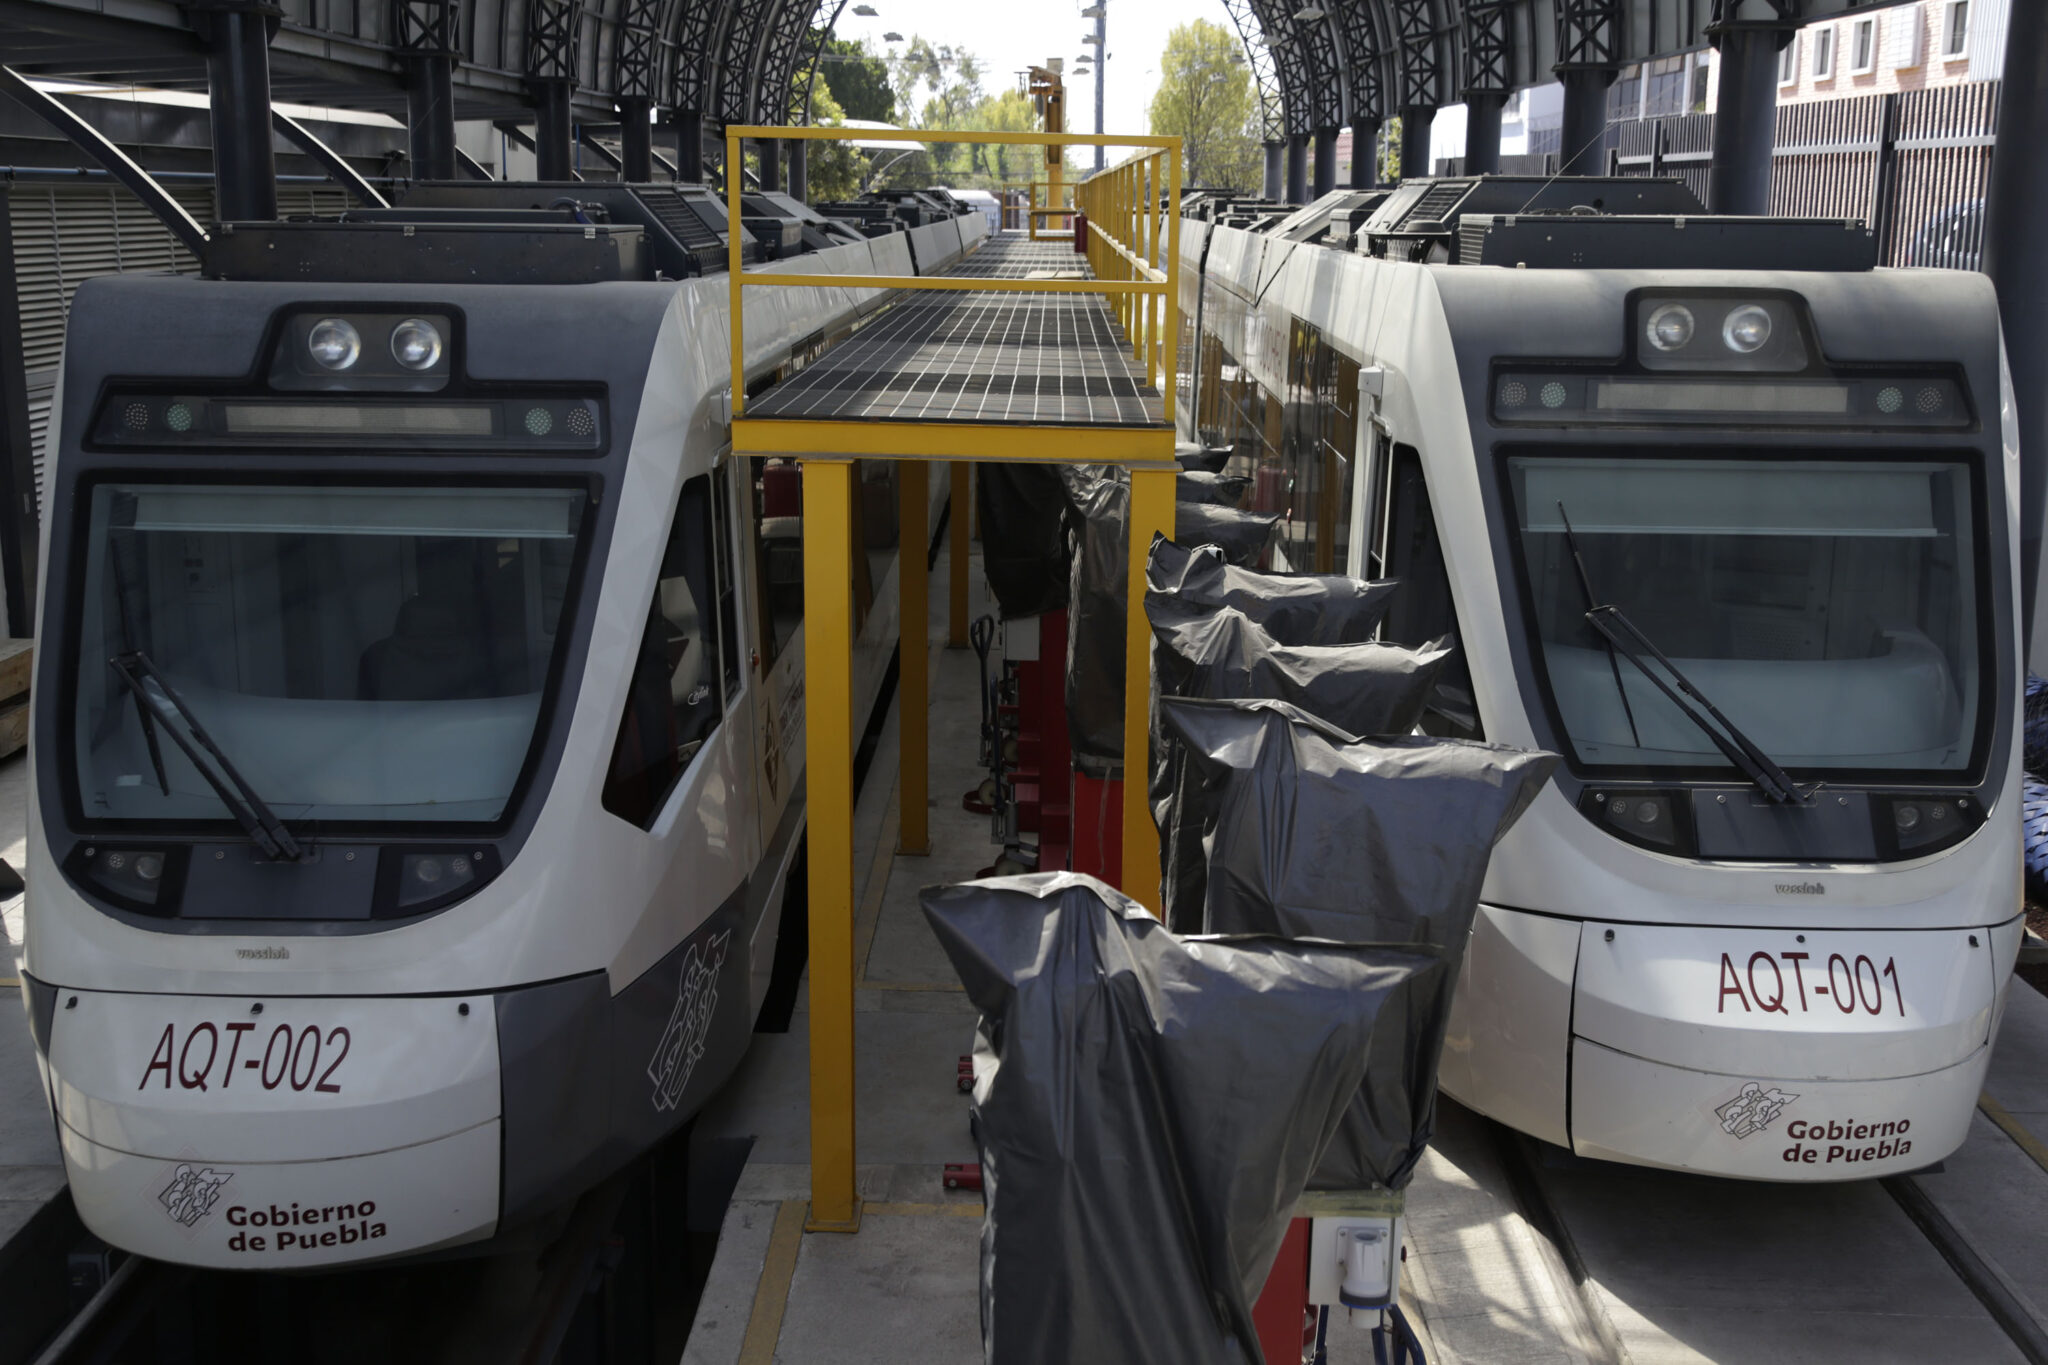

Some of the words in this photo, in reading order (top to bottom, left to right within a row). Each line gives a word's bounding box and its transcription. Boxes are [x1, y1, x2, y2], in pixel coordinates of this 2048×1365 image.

[1718, 951, 1905, 1017] AQT-001
[138, 1022, 351, 1094] AQT-002
[1787, 1119, 1911, 1141] Gobierno
[1782, 1143, 1818, 1164] de
[1826, 1138, 1912, 1164] Puebla
[226, 1201, 376, 1228] Gobierno
[228, 1232, 266, 1252] de
[276, 1221, 387, 1250] Puebla
